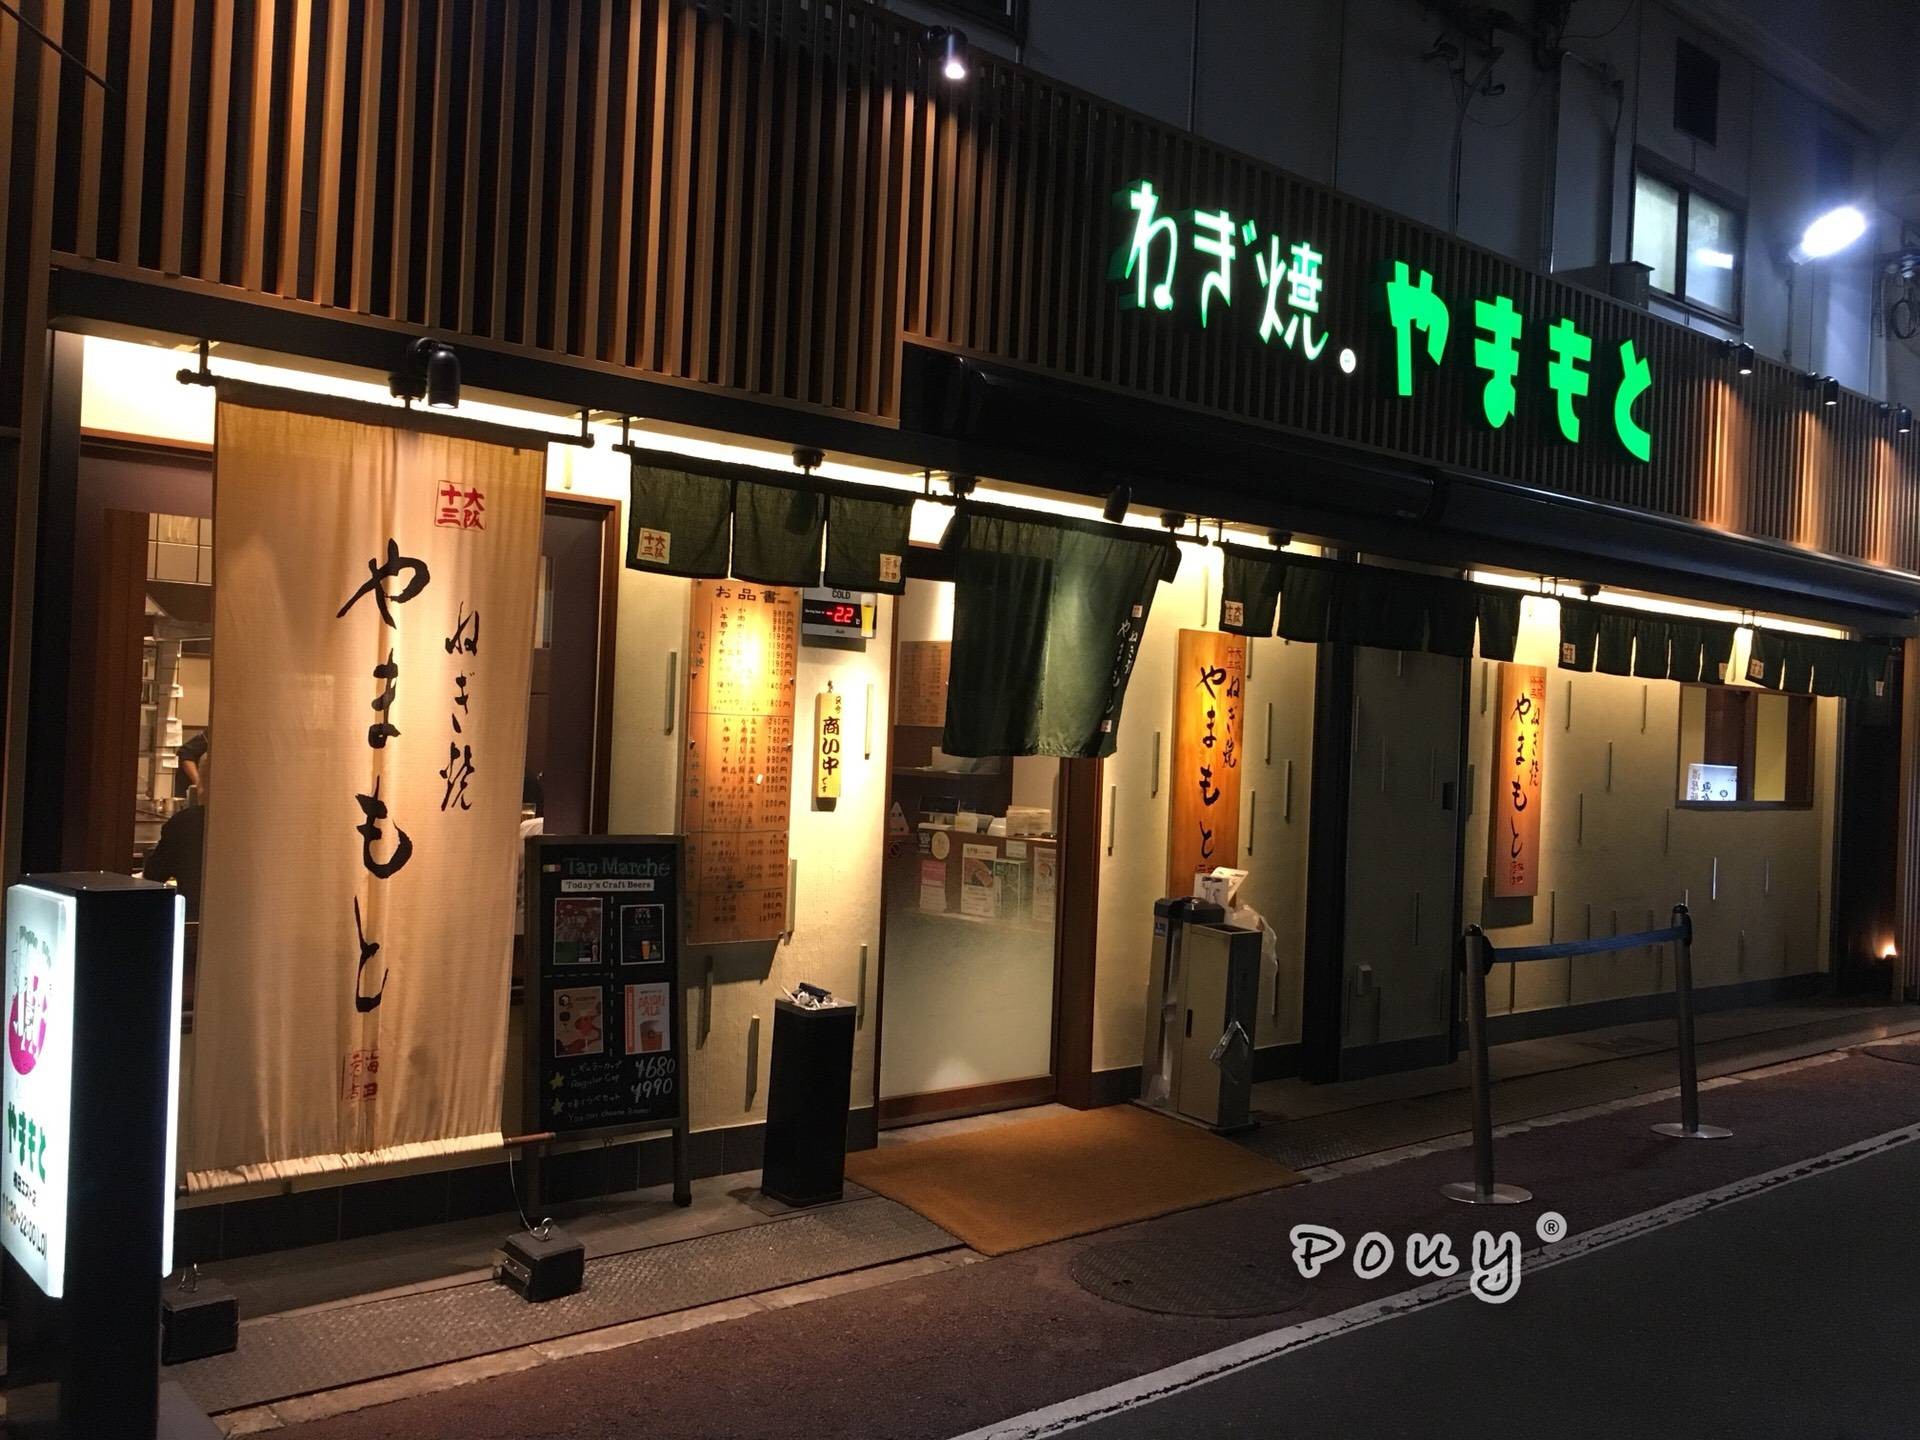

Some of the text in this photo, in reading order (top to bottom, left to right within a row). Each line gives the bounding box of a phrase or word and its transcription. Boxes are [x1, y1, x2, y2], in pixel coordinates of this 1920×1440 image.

[1386, 259, 1653, 463] やまもと
[439, 484, 462, 526] 十三
[463, 487, 486, 531] 大阪
[831, 589, 851, 600] COLD
[336, 538, 431, 1014] やまもと
[822, 715, 840, 776] 商い中
[1195, 664, 1227, 859] やまもと
[1510, 692, 1532, 859] やまもと
[563, 857, 598, 877] Tap
[566, 880, 652, 890] Today's Craft Beers
[7, 1101, 46, 1185] やまもと
